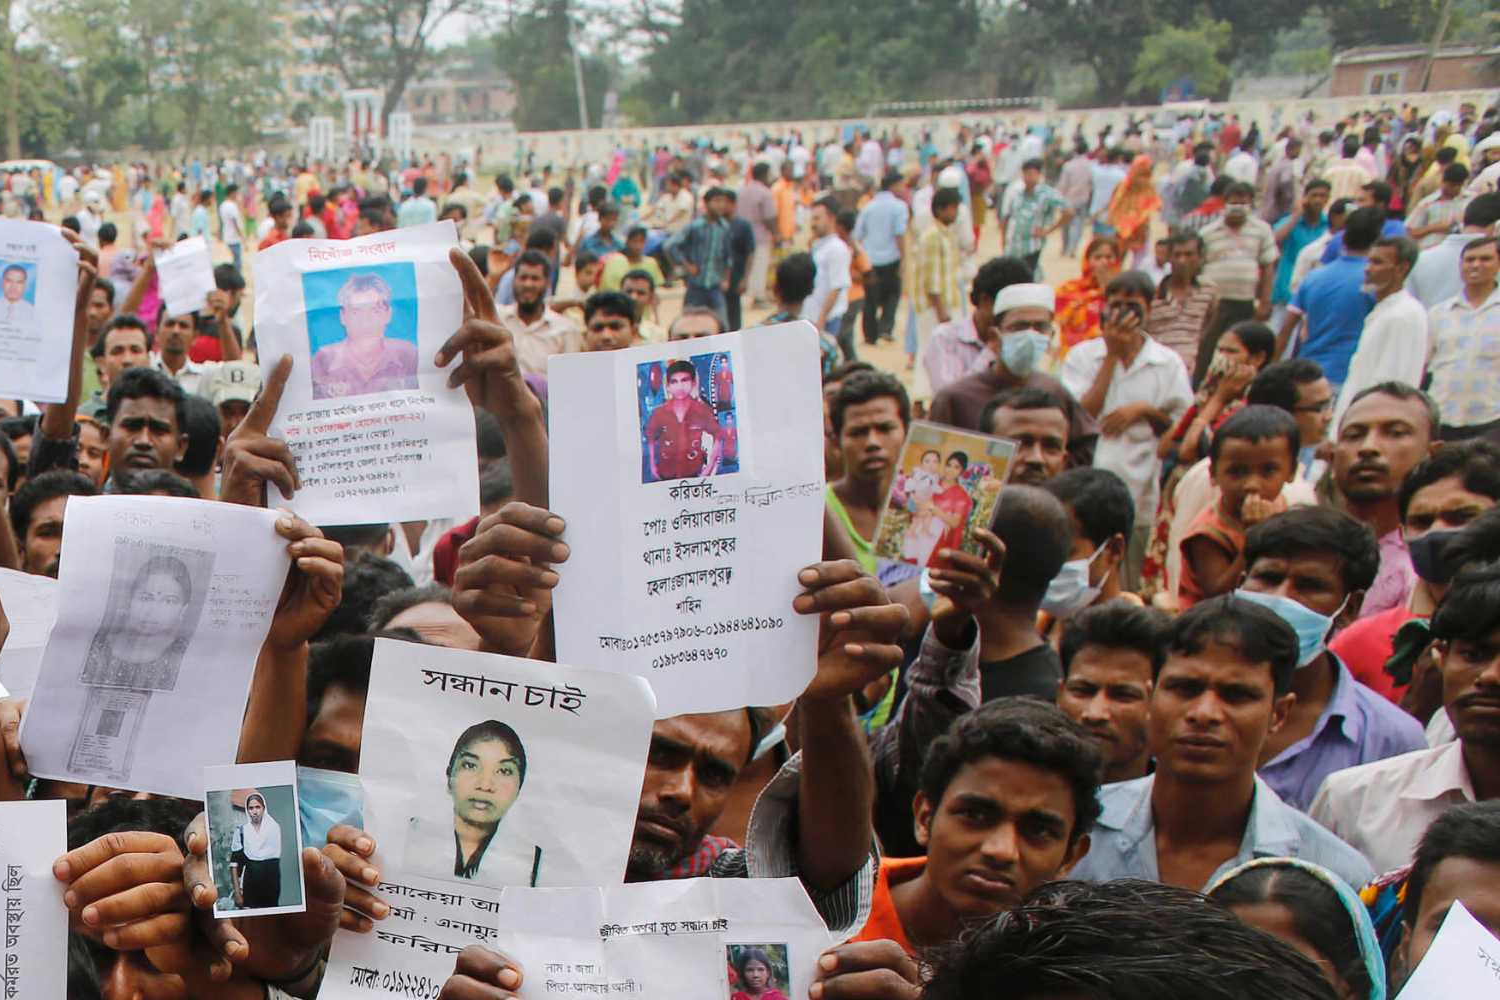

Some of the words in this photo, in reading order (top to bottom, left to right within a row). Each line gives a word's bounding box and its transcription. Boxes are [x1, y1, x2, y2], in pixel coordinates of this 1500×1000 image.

[643, 518, 667, 537] পোঃ
[643, 548, 671, 567] থানাঃ
[421, 669, 518, 703] সন্ধান
[523, 683, 587, 716] চাই
[3, 864, 23, 892] ছিল
[377, 882, 464, 907] রোকেয়া
[5, 897, 23, 948] অবস্থায়
[660, 921, 678, 936] মৃত
[0, 952, 20, 1000] কর্মরত
